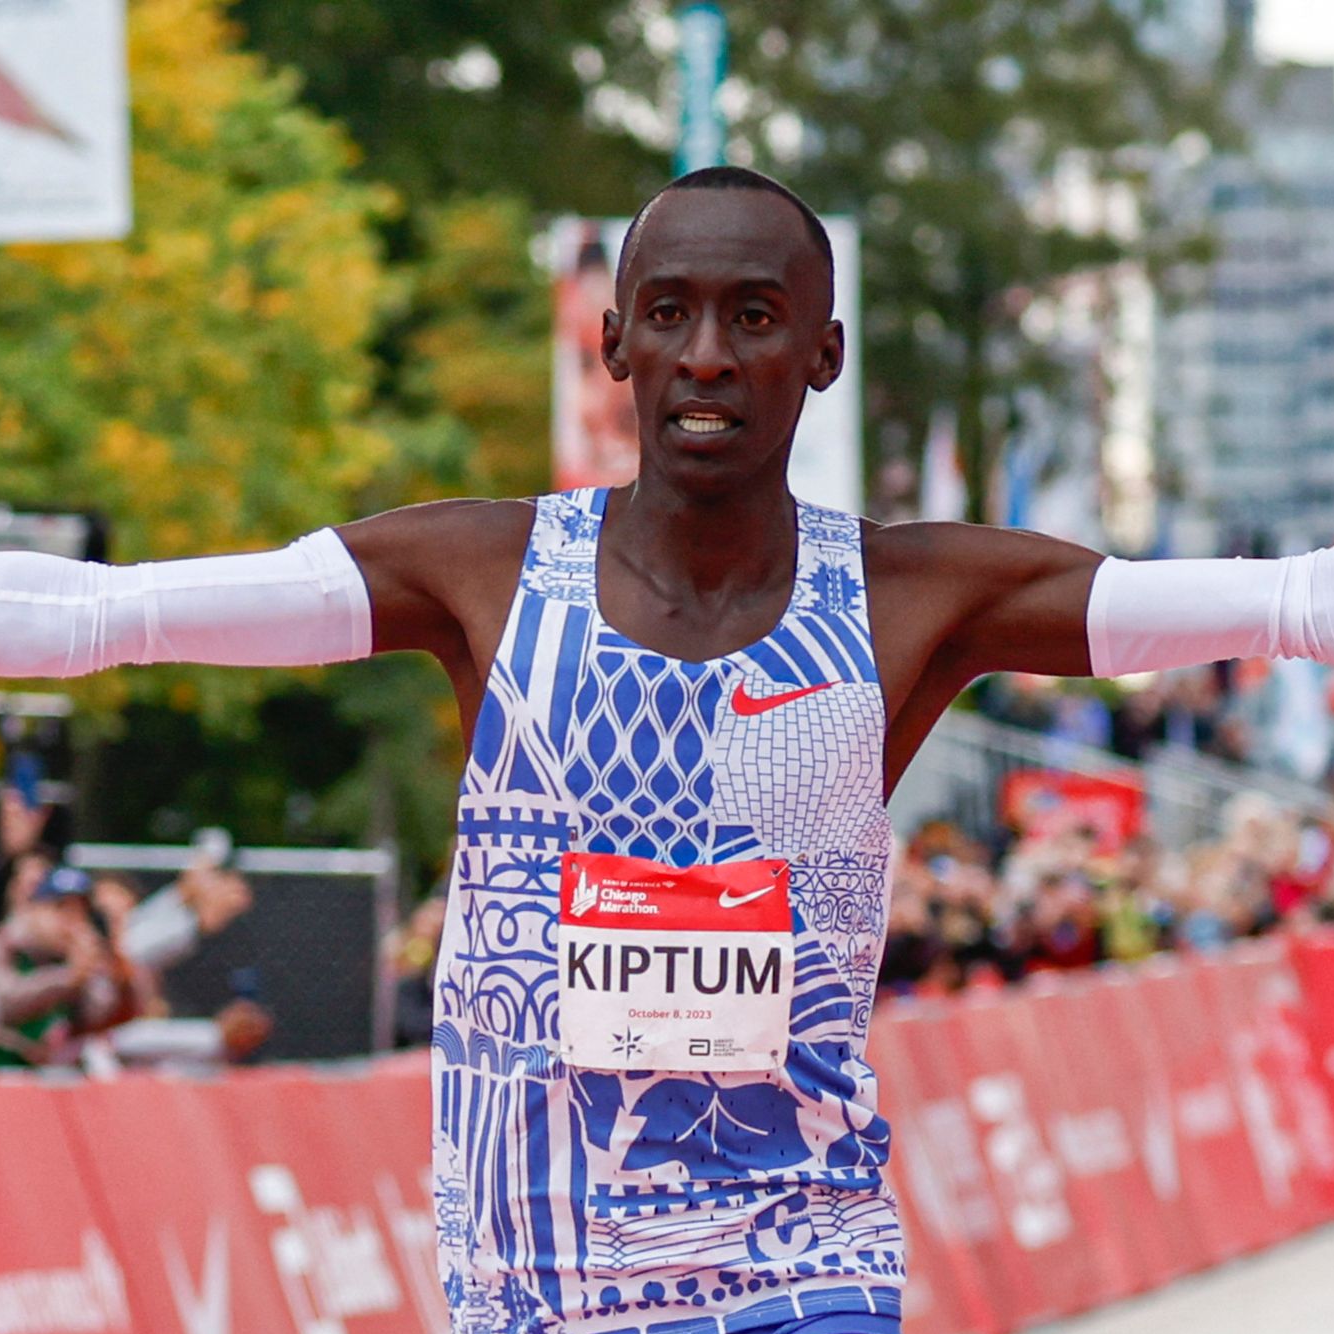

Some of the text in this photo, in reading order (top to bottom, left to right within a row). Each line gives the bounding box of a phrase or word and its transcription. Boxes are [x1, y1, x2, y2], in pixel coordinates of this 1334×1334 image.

[600, 888, 647, 904] Chicago
[567, 941, 782, 995] KIPTUM
[628, 1008, 712, 1020] October 8, 2023
